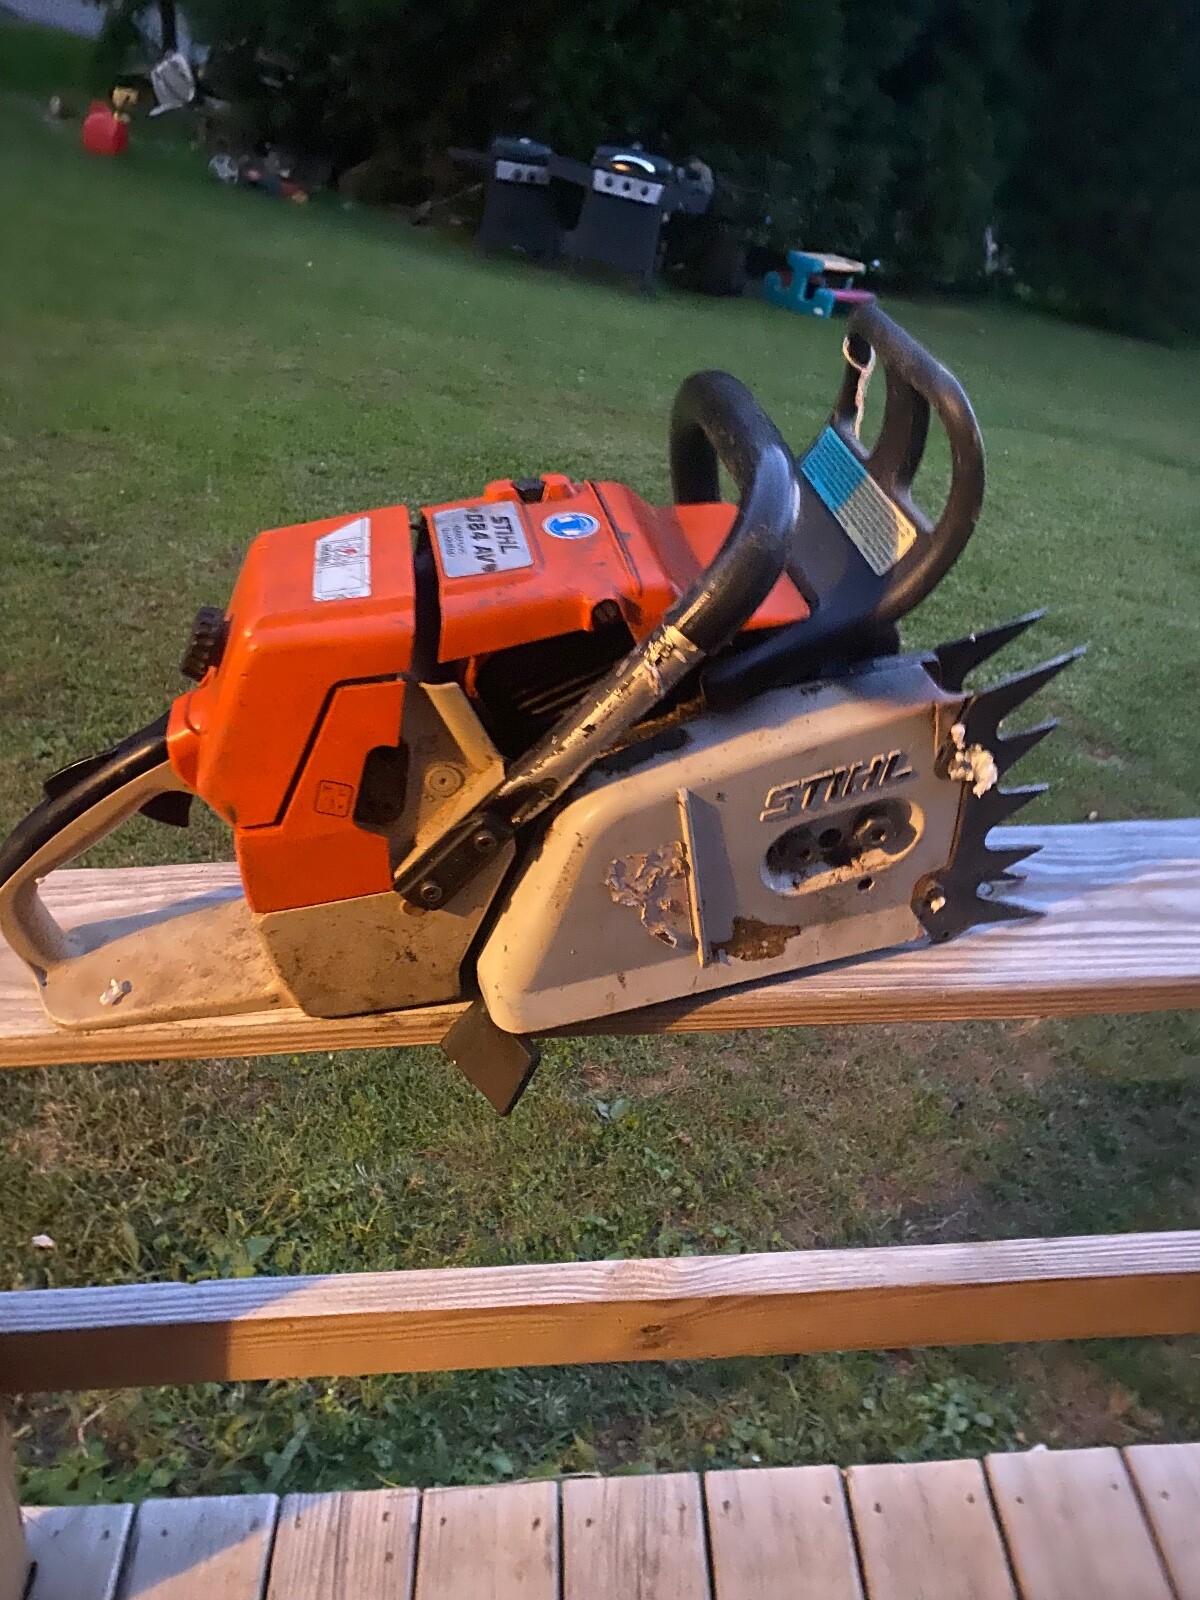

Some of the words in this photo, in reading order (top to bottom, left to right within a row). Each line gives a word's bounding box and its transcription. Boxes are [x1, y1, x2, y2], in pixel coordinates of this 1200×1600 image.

[490, 516, 520, 554] STIHL
[473, 545, 496, 564] AV
[759, 749, 913, 822] STIHL
